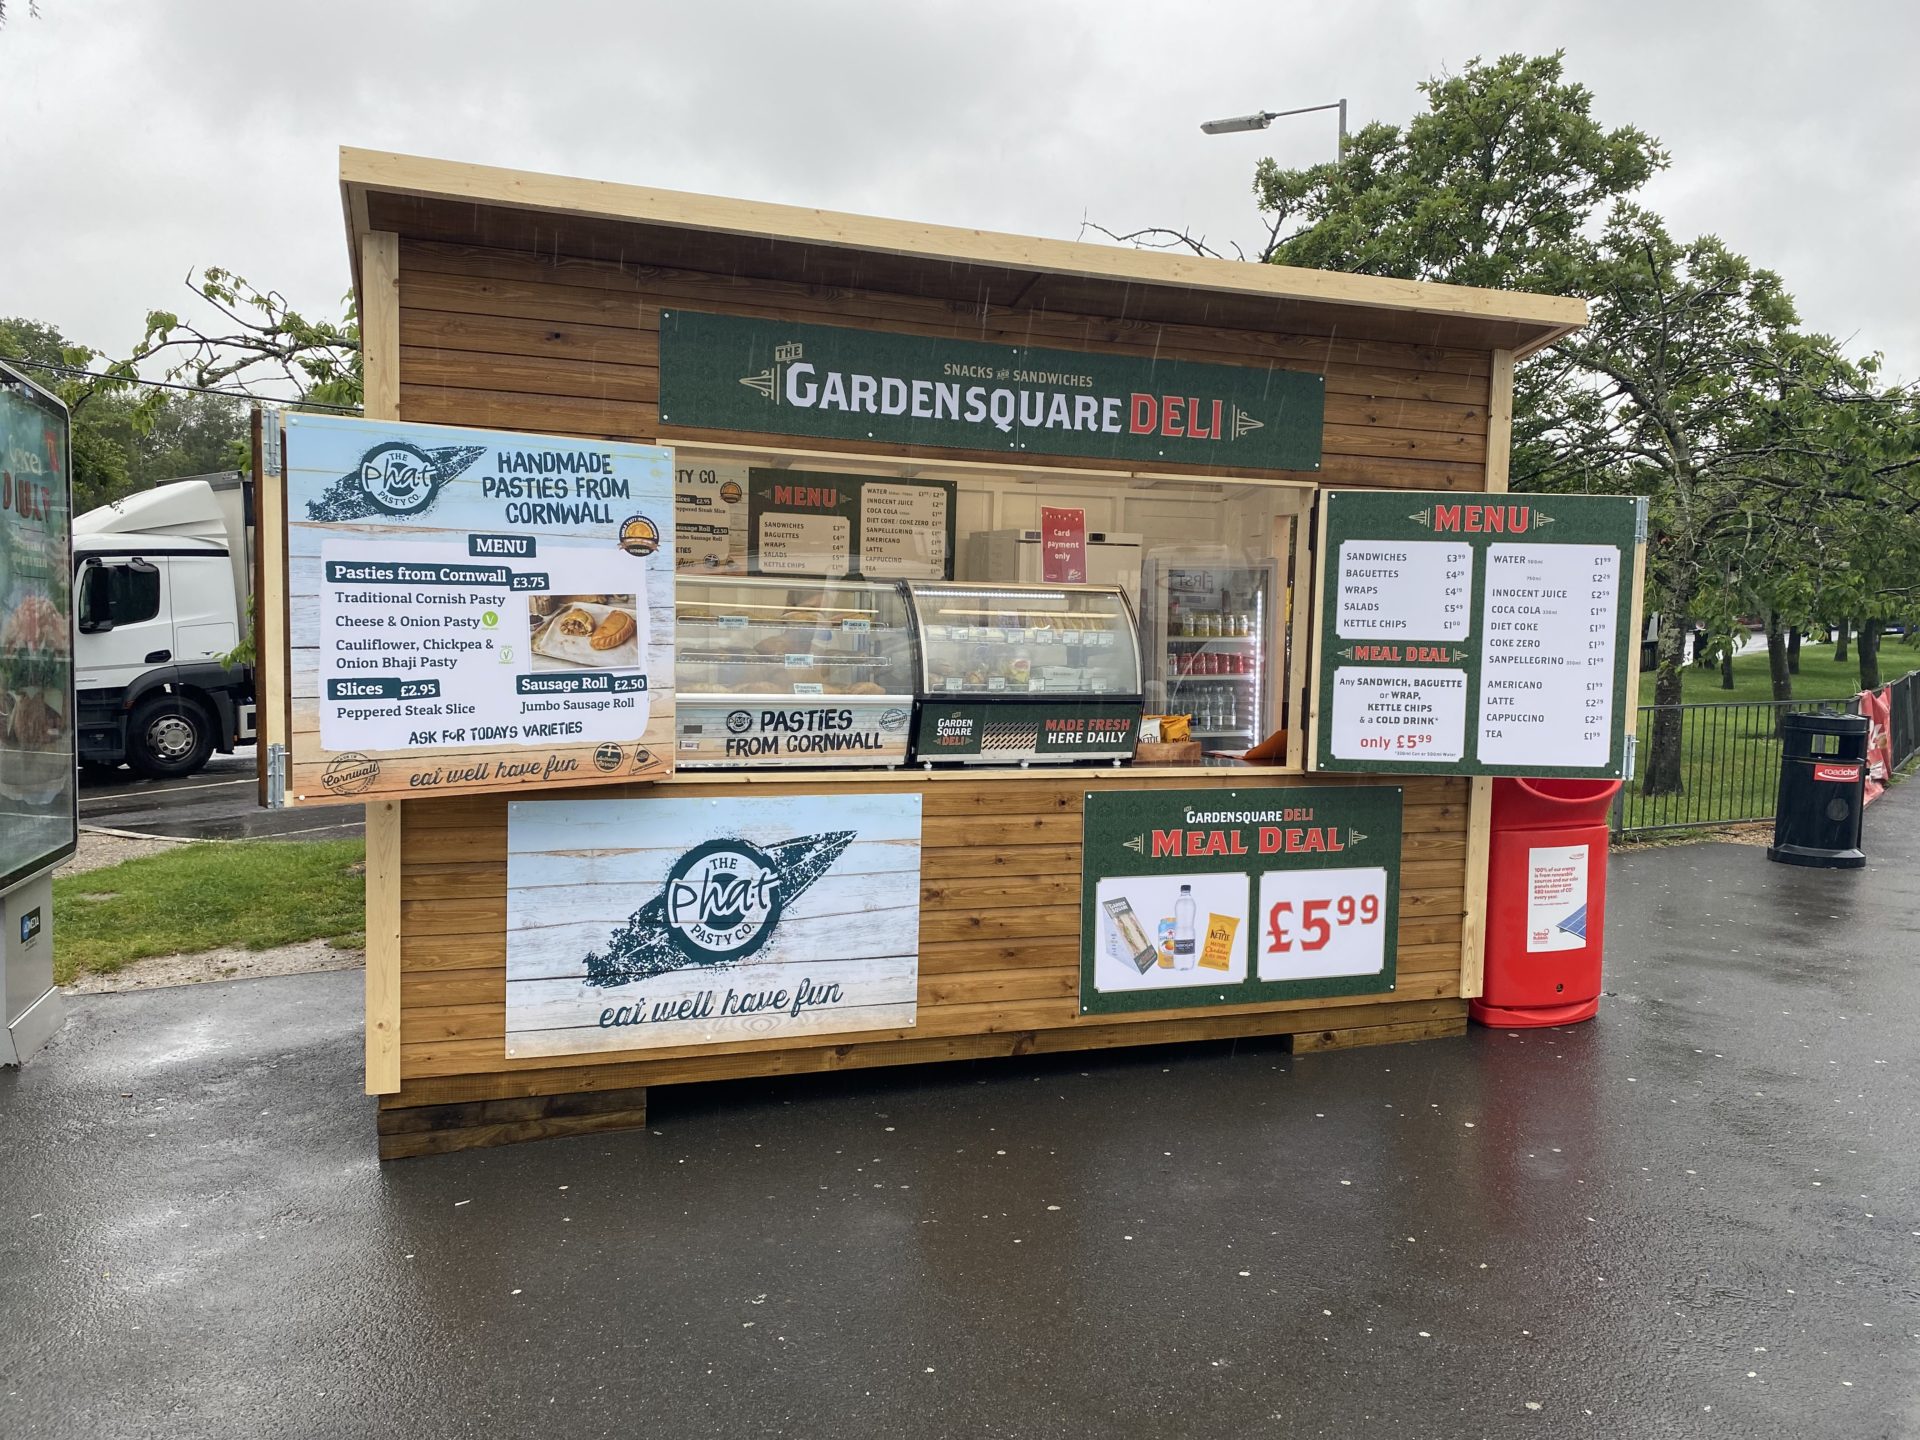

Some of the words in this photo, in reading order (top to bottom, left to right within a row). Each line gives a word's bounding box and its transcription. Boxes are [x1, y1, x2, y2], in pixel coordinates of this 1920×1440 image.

[777, 347, 800, 358] THE
[944, 364, 993, 379] SNACKS
[1013, 370, 1093, 388] SANDWICHES
[1129, 393, 1223, 440] DELI
[389, 453, 407, 461] THE
[497, 451, 612, 473] HANDMADE
[700, 470, 718, 484] CO.
[483, 477, 569, 499] PASTIES
[575, 478, 630, 499] FROM
[378, 491, 406, 505] PASTY
[408, 495, 421, 504] CO.
[774, 485, 837, 507] MENU
[506, 502, 614, 524] CORNWALL
[1434, 505, 1529, 533] MENU
[476, 539, 527, 554] MENU
[1048, 541, 1079, 549] payment
[1055, 553, 1070, 561] only
[1347, 553, 1407, 561] SANDWICHES
[335, 566, 393, 580] Pasties
[397, 567, 436, 581] from
[440, 568, 506, 582] Cornwall
[513, 576, 545, 589] £3.75
[1346, 570, 1399, 578] BAGUETTES
[1345, 586, 1378, 594] WRAPS
[1492, 589, 1539, 597] INNOCENT
[1541, 590, 1567, 598] JUICE
[335, 593, 412, 604] Traditional
[415, 593, 466, 605] Cornish
[469, 594, 505, 607] Pasty
[1344, 603, 1379, 611] SALADS
[1491, 606, 1515, 614] COCA
[1518, 606, 1541, 614] COLA
[336, 615, 384, 627] Cheese
[387, 616, 396, 627] &
[400, 615, 440, 627] Onion
[443, 616, 480, 630] Pasty
[1380, 620, 1406, 628] CHIPS
[1515, 623, 1538, 631] COKE
[336, 639, 419, 652] Cauliflower,
[423, 638, 482, 653] Chickpea
[485, 640, 494, 650] &
[1490, 639, 1513, 647] COKE
[1355, 646, 1402, 661] MEAL
[1406, 647, 1450, 662] DEAL
[1489, 656, 1564, 664] SANPELLEGRINO
[336, 657, 378, 668] Onion
[382, 656, 416, 671] Bhaji
[420, 656, 457, 670] Pasty
[337, 682, 383, 696] Slices
[401, 684, 435, 696] £2.95
[521, 678, 578, 691] Sausage
[582, 677, 608, 689] Roll
[614, 678, 644, 691] £2.50
[1340, 678, 1354, 686] Any
[1357, 679, 1411, 687] SANDWICH,
[1414, 680, 1462, 688] BAGUETTE
[1488, 681, 1542, 689] AMERICANO
[520, 700, 559, 714] Jumbo
[563, 699, 609, 712] Sausage
[613, 698, 634, 708] Roll
[1488, 697, 1514, 705] LATTE
[337, 706, 401, 719] Peppered
[405, 704, 442, 716] Steak
[445, 703, 475, 715] Slice
[1405, 704, 1432, 712] CHIPS
[938, 718, 973, 727] GARDEN
[1487, 714, 1544, 722] CAPPUCCINO
[937, 727, 972, 736] SQUARE
[1045, 720, 1084, 731] MADE
[1088, 719, 1130, 731] FRESH
[408, 731, 438, 744] ASK
[470, 725, 517, 741] TODAYS
[523, 722, 582, 738] VARIETIES
[1048, 732, 1083, 744] HERE
[1087, 732, 1126, 743] DAILY
[1486, 730, 1502, 738] TEA
[726, 736, 778, 757] FROM
[787, 732, 882, 752] CORNWALL
[943, 737, 964, 745] DELI
[1361, 736, 1391, 750] only
[324, 764, 378, 786] Cornwall
[410, 767, 443, 787] eat
[447, 762, 489, 783] well
[496, 761, 542, 779] have
[545, 755, 579, 779] fun
[1824, 768, 1858, 776] roadchef
[1284, 808, 1313, 821] DELI
[1151, 829, 1248, 857] MEAL
[1258, 827, 1345, 853] DEAL
[710, 858, 738, 870] THE
[691, 924, 732, 946] PASTY
[736, 924, 755, 942] CO.
[600, 998, 646, 1028] eat
[652, 990, 713, 1021] well
[721, 988, 788, 1016] have
[790, 978, 843, 1018] fun
